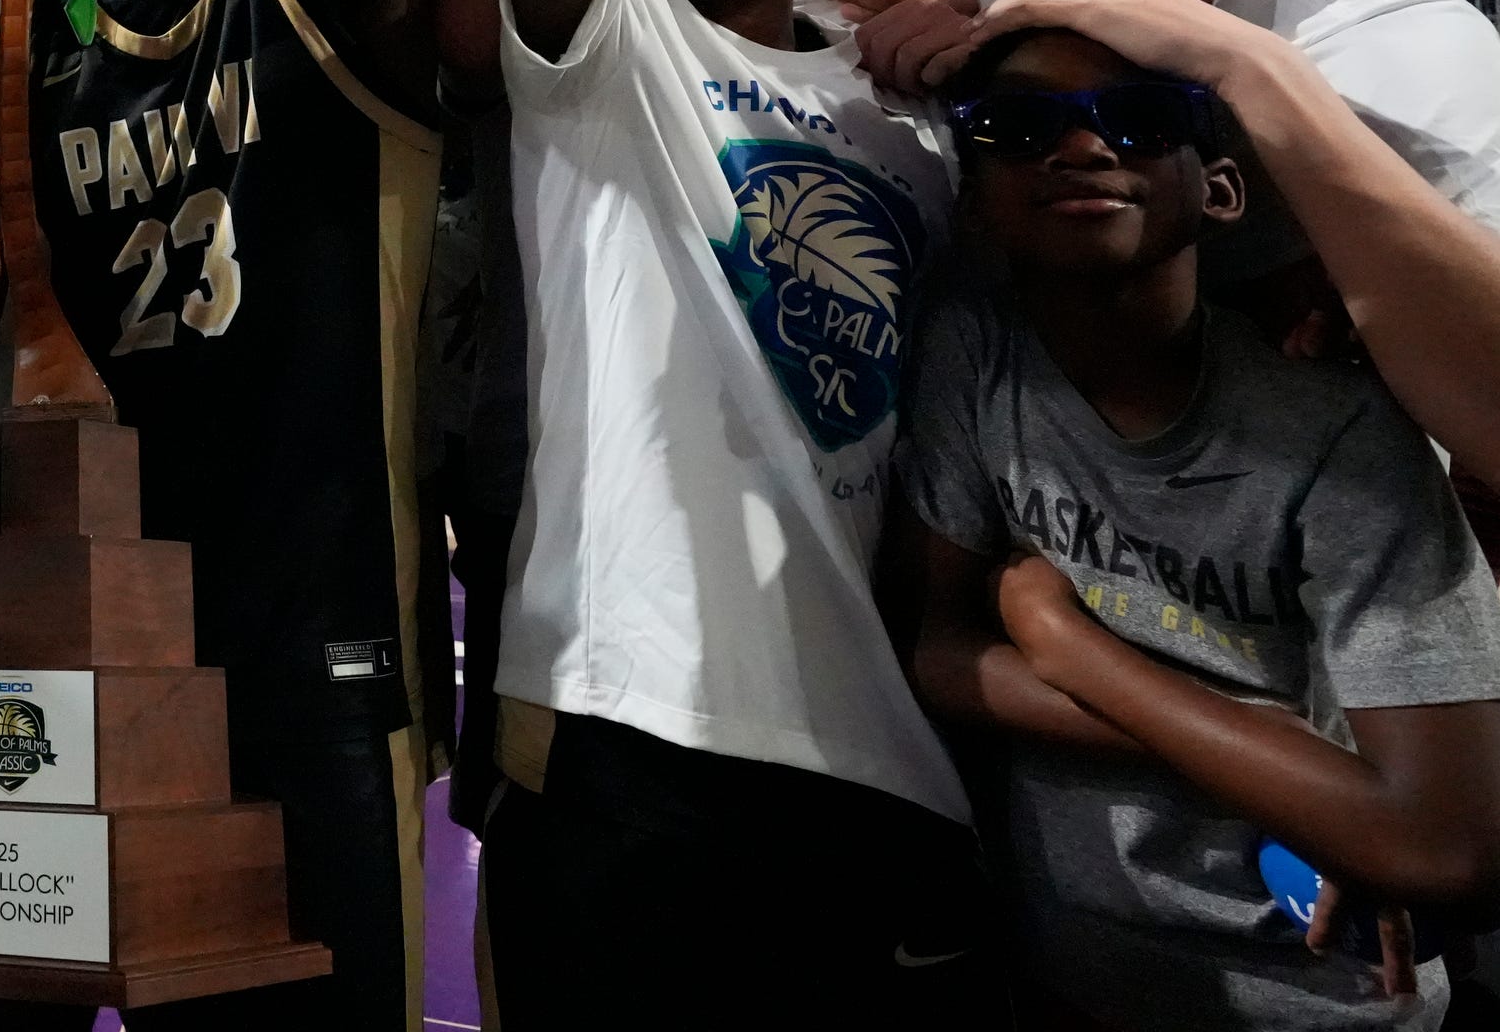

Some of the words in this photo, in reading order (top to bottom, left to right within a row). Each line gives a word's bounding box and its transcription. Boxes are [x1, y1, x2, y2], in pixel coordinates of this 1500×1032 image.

[109, 187, 242, 358] 23
[821, 298, 903, 360] PALM
[382, 650, 392, 666] L
[0, 736, 16, 750] OF
[18, 737, 49, 754] PALMS
